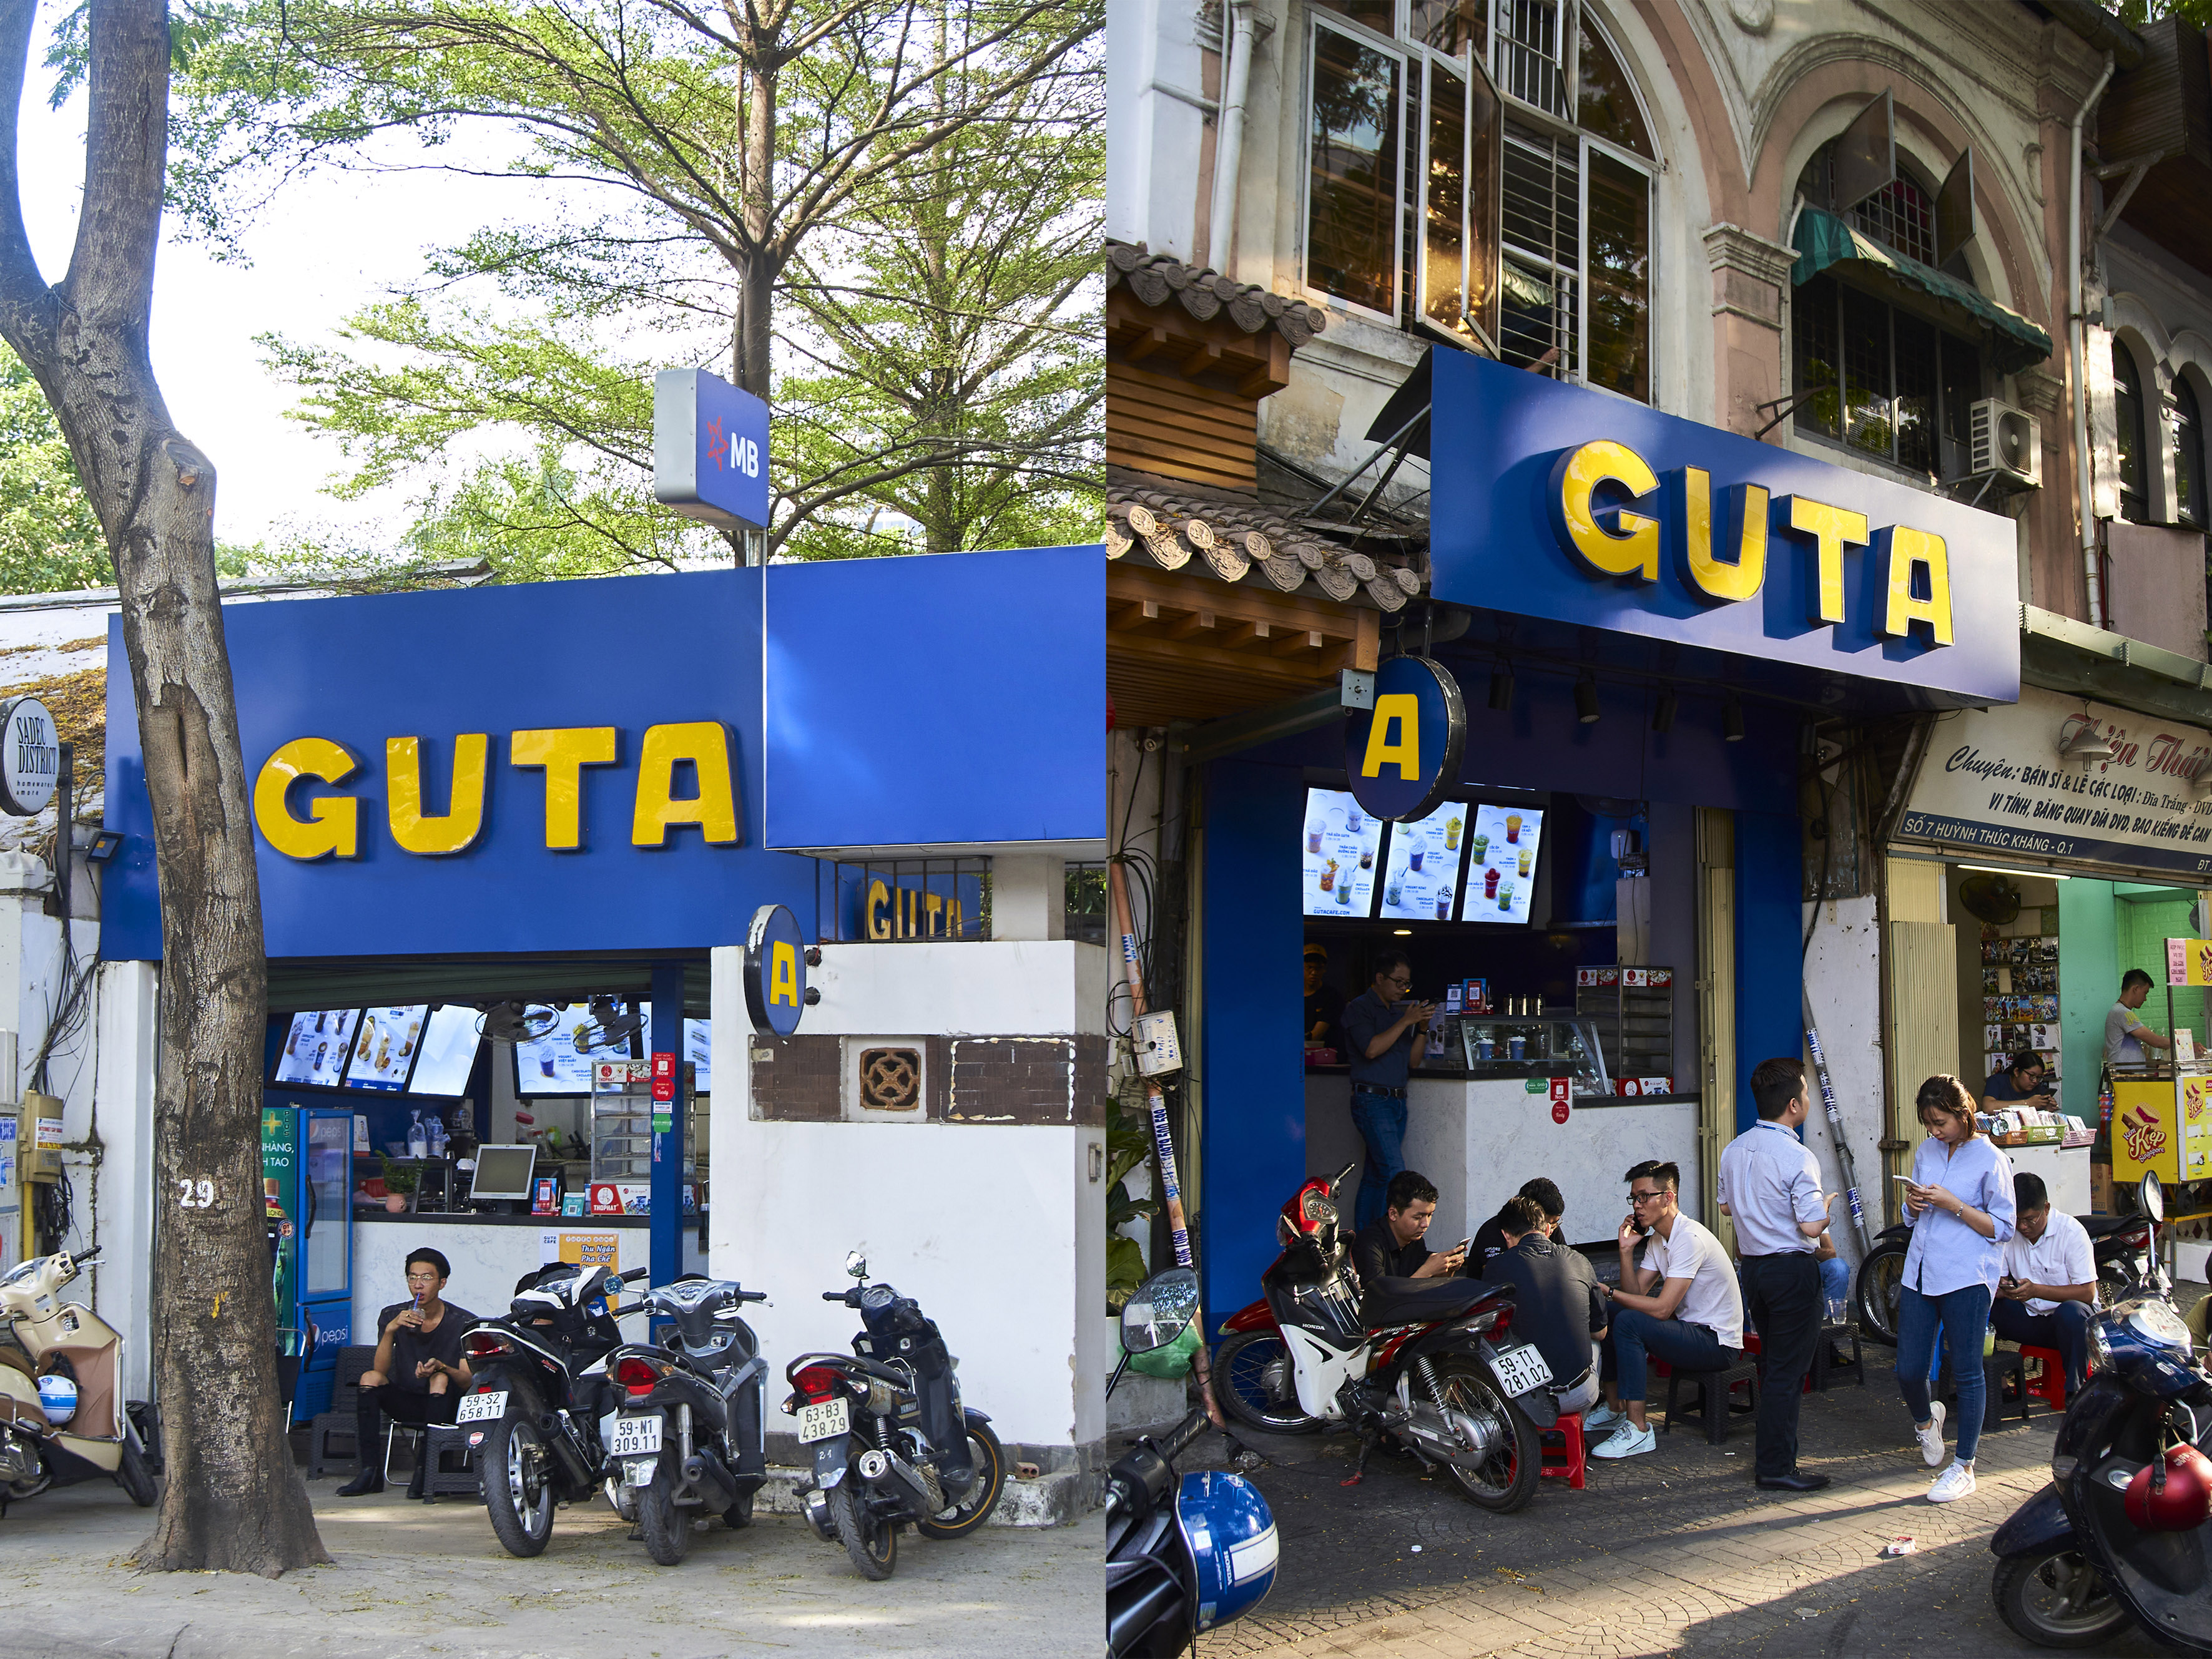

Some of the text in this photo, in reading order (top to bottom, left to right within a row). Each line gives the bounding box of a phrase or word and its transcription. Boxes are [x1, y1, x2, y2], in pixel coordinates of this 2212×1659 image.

[730, 432, 759, 478] MB
[1562, 440, 1955, 646] GUTA
[1361, 693, 1420, 781] A
[18, 745, 57, 775] DISTRICT
[2145, 733, 2210, 780] Thái
[253, 721, 739, 860] GUTA
[1945, 745, 2021, 781] Chuyên:
[2020, 765, 2050, 788] BÁN
[2062, 775, 2071, 790] &
[2089, 777, 2111, 798] CÁC
[2110, 783, 2138, 805] LOẠI
[2161, 793, 2188, 815] Trắng
[1988, 792, 2004, 810] VI
[2002, 791, 2032, 818] TÍNH,
[2032, 798, 2065, 821] BĂNG
[2063, 806, 2093, 825] QUAY
[2131, 816, 2152, 834] BAO
[2191, 826, 2212, 843] CAN
[1904, 815, 1927, 833] SỐ
[1925, 821, 1935, 835] 7
[1934, 821, 1977, 841] HUỲNH
[1979, 828, 2010, 846] THÚC
[2010, 833, 2050, 852] KHÁNG
[2057, 841, 2074, 855] Q.1
[769, 940, 798, 1007] A
[2123, 1128, 2136, 1140] Kem
[2138, 1147, 2165, 1163] Singapore
[179, 1178, 214, 1208] 29
[267, 1209, 283, 1217] LONG
[581, 1245, 616, 1254] Thu Ngân
[581, 1253, 612, 1263] Pha Chế
[321, 1324, 348, 1346] pepsi
[1498, 1349, 1535, 1375] 59-T1
[1504, 1364, 1549, 1394] 281.02
[460, 1405, 501, 1421] 658.11
[466, 1393, 500, 1407] 59-S2
[805, 1402, 840, 1423] 63-B3
[619, 1419, 653, 1437] 59-N1
[803, 1417, 846, 1440] 438.29
[614, 1434, 657, 1454] 309.11
[818, 1449, 832, 1461] 21
[1223, 1550, 1232, 1586] HONDA
